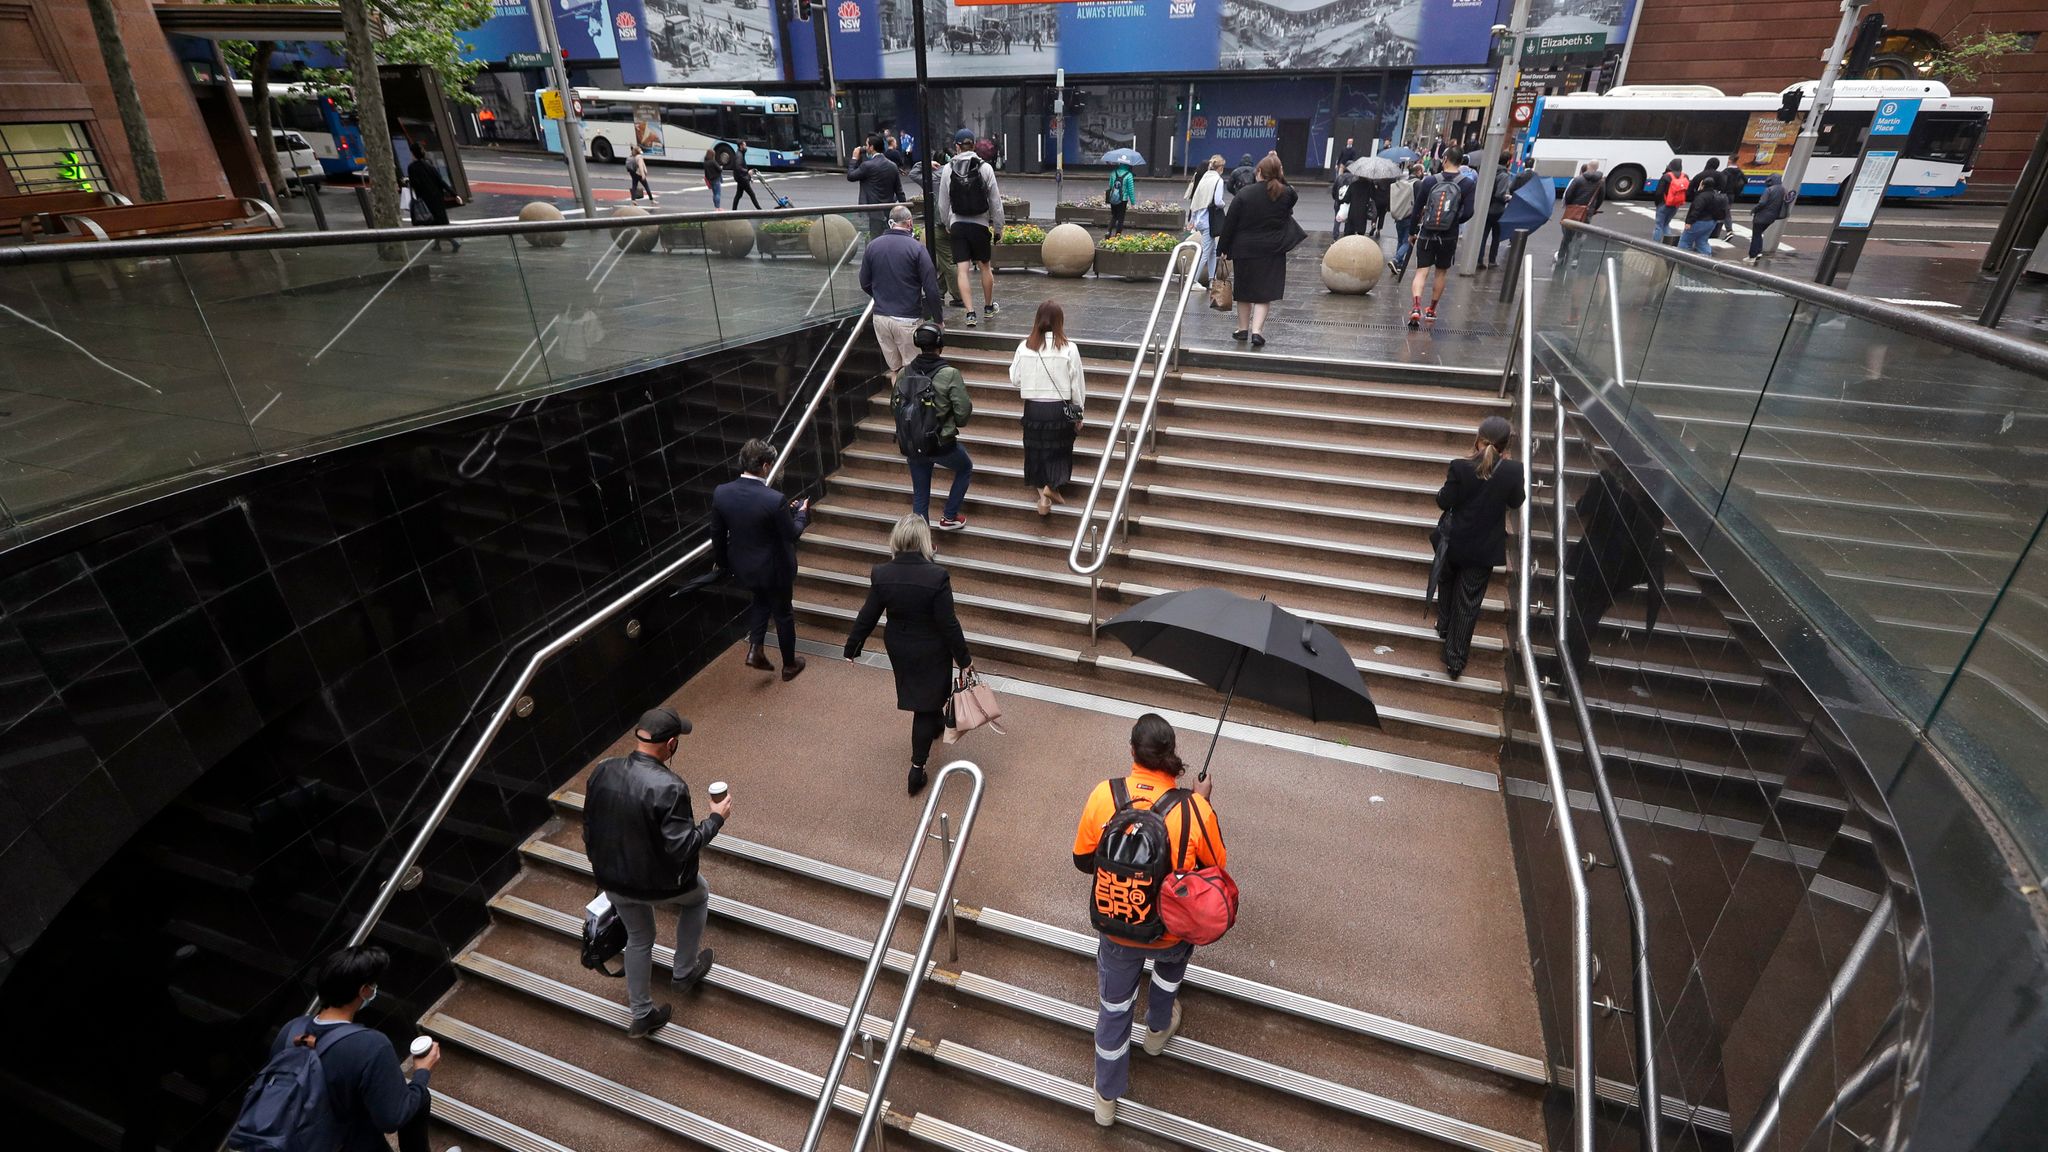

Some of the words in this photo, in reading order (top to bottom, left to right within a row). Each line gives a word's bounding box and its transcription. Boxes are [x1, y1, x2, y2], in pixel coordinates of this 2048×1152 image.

[1077, 7, 1106, 19] ALWAYS
[1107, 5, 1147, 18] EVOLVING.
[1169, 3, 1196, 14] NSW
[839, 19, 860, 28] NSW
[618, 27, 637, 37] NSW
[1541, 35, 1583, 48] Elizabeth
[1584, 35, 1593, 45] St
[518, 53, 536, 62] Martin
[1217, 115, 1252, 127] SYDNEY'S
[1190, 128, 1207, 136] NSW
[1216, 128, 1241, 139] METRO
[1243, 127, 1276, 138] RAILWAY.
